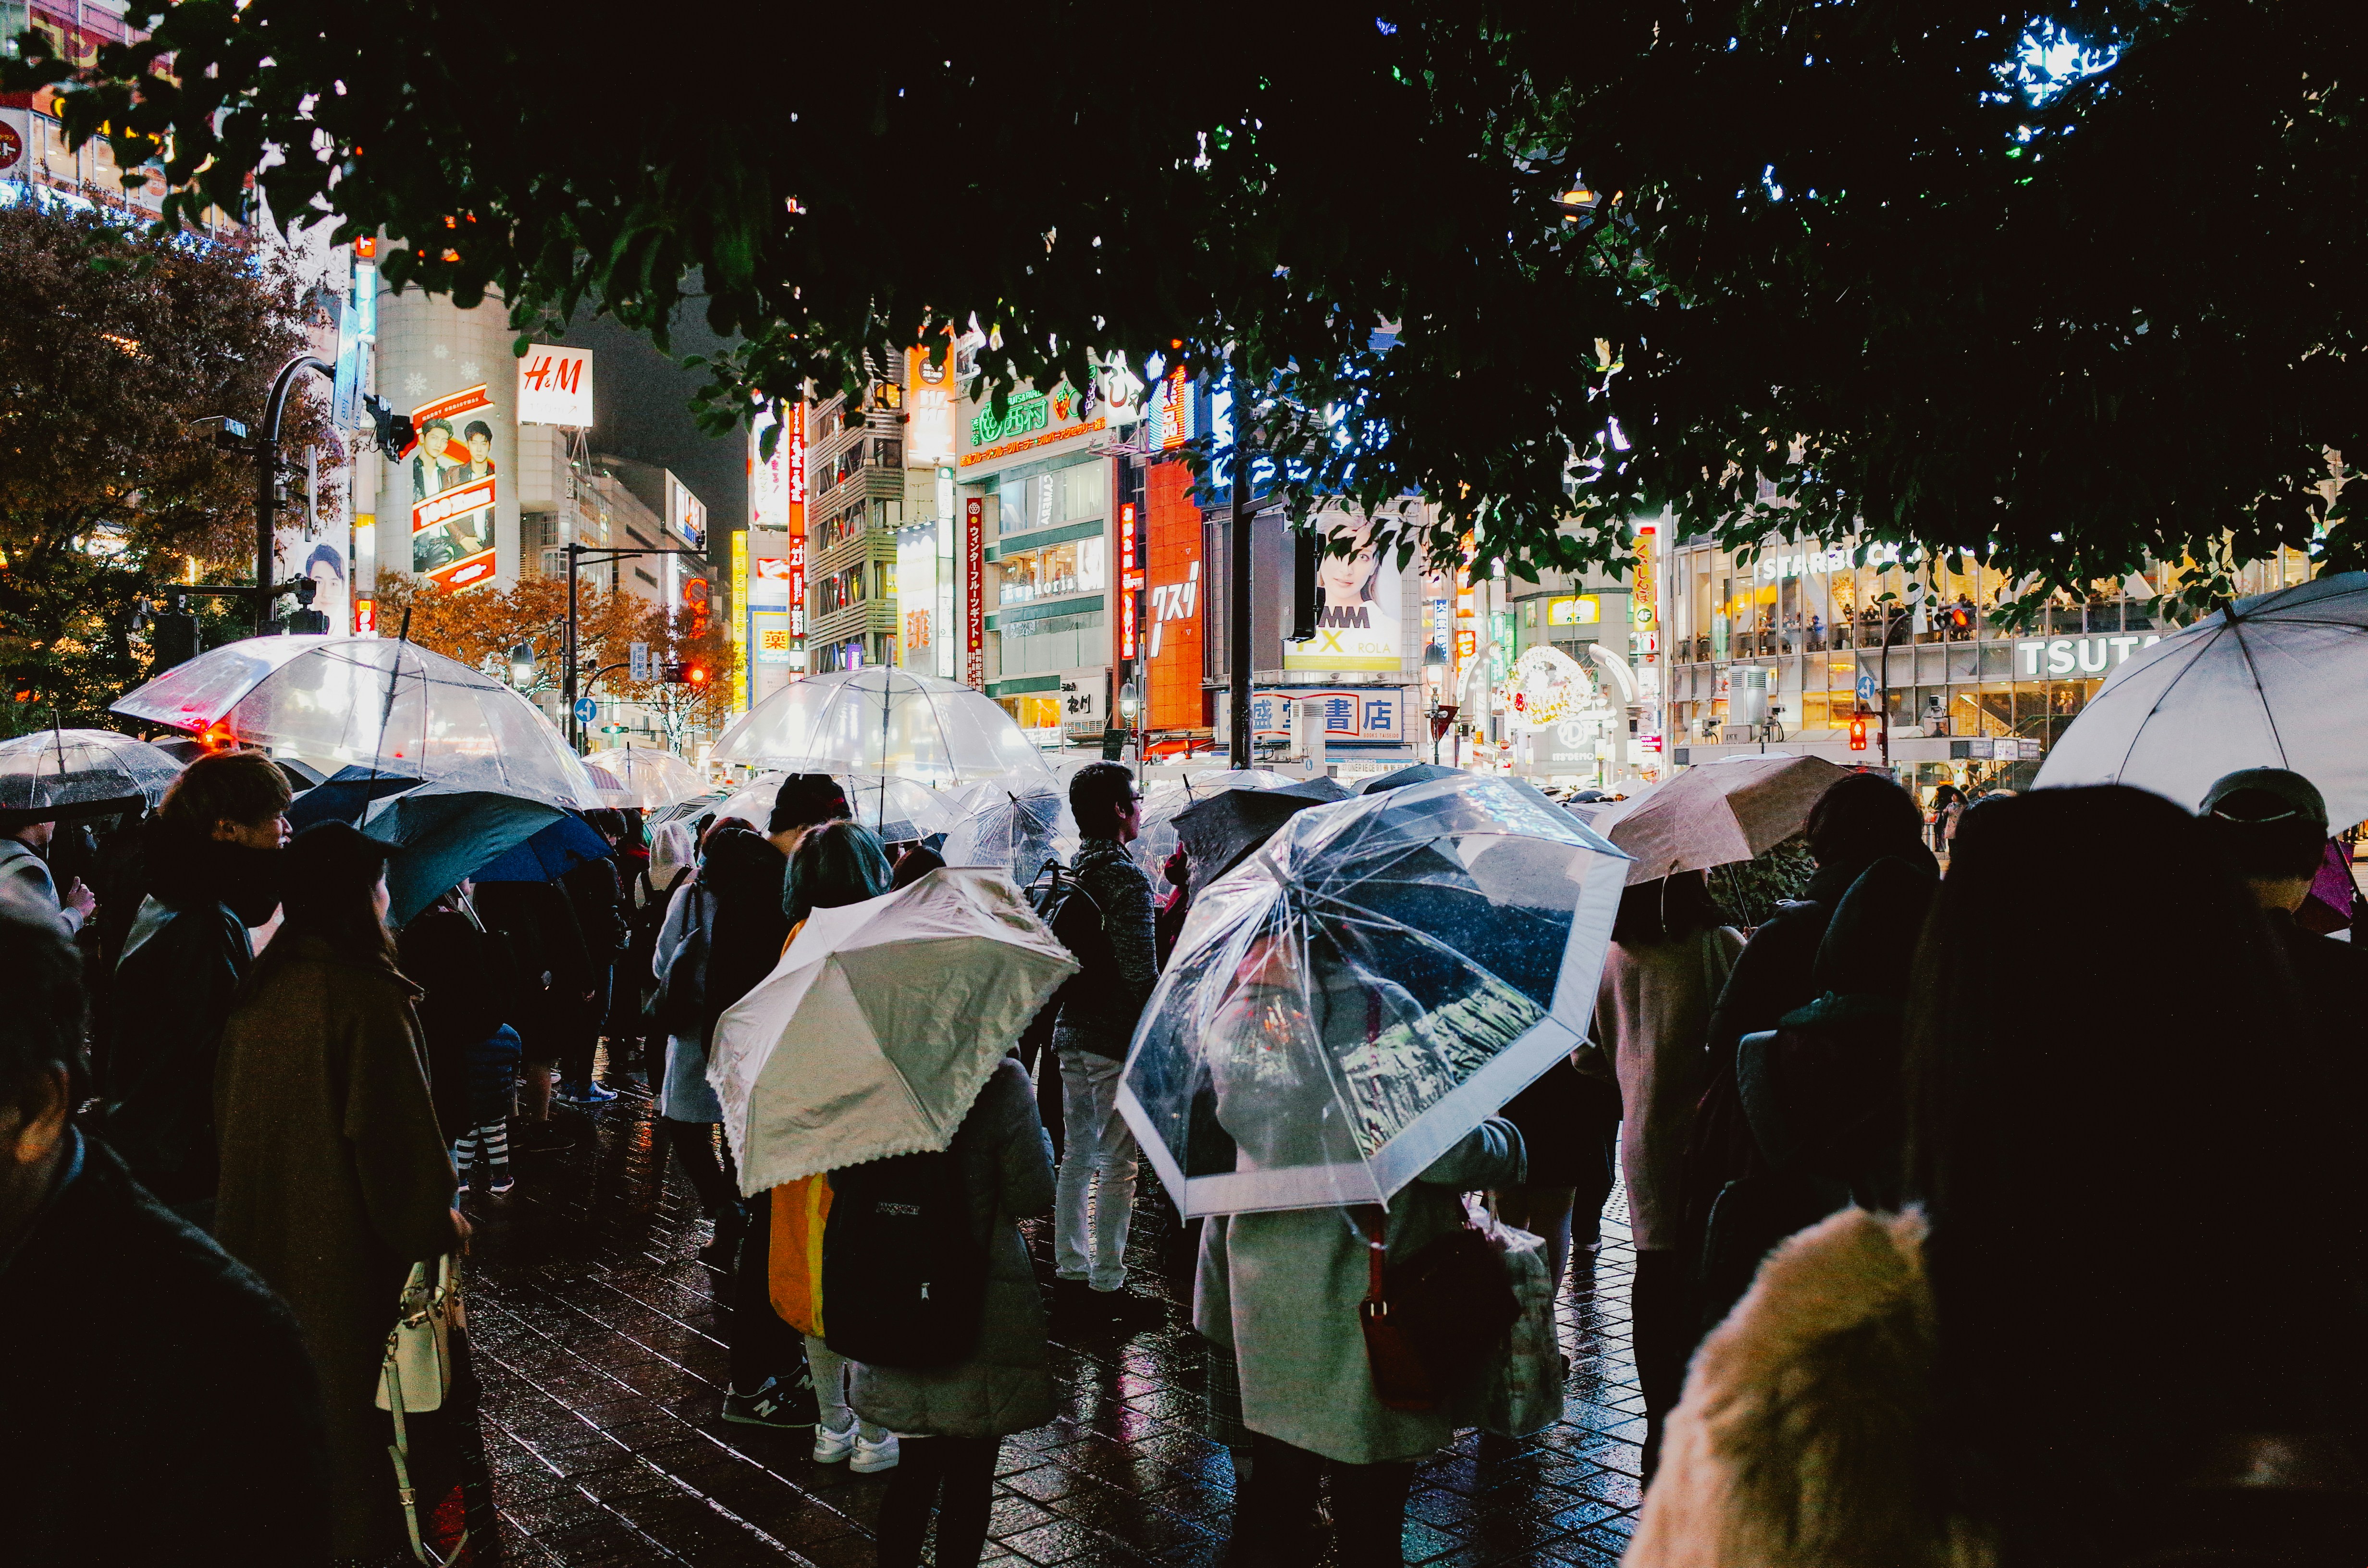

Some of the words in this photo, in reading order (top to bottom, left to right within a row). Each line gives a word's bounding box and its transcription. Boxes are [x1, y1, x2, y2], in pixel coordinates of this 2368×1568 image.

[524, 355, 582, 395] H&M
[1005, 398, 1048, 436] 西村
[969, 527, 980, 638] ウィンターフルーツギフト
[1005, 576, 1074, 601] Euphoria
[1318, 606, 1371, 628] MM
[1637, 610, 1651, 621] 4F
[765, 631, 787, 649] 薬
[1358, 643, 1391, 653] ROLA
[1227, 698, 1392, 730] 盛書店
